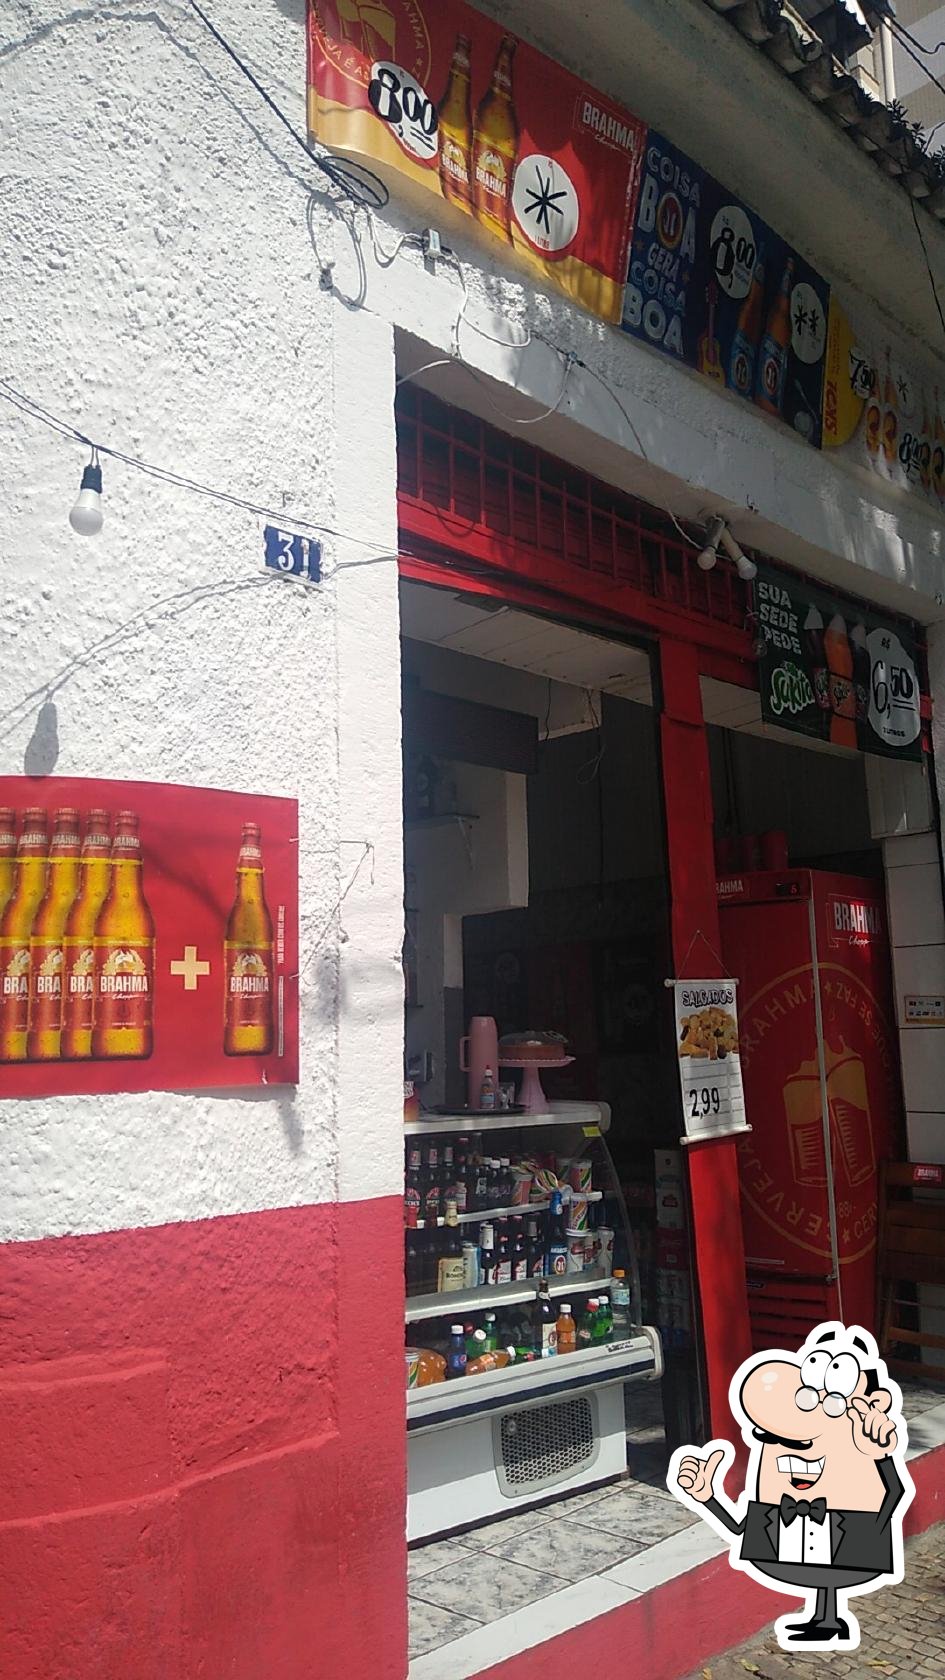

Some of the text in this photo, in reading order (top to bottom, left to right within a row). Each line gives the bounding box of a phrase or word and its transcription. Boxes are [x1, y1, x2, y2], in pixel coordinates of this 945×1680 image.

[582, 101, 635, 151] BRAHMA
[442, 153, 469, 184] BRAHMA
[476, 166, 506, 198] BRAHMA
[646, 146, 701, 209] COISA
[638, 172, 697, 264] BOA
[648, 242, 681, 283] GERA
[631, 261, 687, 317] COISA
[622, 282, 684, 356] BOA
[278, 531, 309, 578] 31
[758, 582, 792, 610] SUA
[759, 603, 799, 634] SEDE
[761, 624, 802, 656] PEDE
[834, 902, 881, 934] BRAHMA
[100, 976, 148, 992] BRAHMA
[230, 976, 269, 992] BRAHMA
[682, 988, 734, 1008] SALGADOS
[689, 1087, 720, 1119] 2,99
[737, 1137, 832, 1243] ERVEJA
